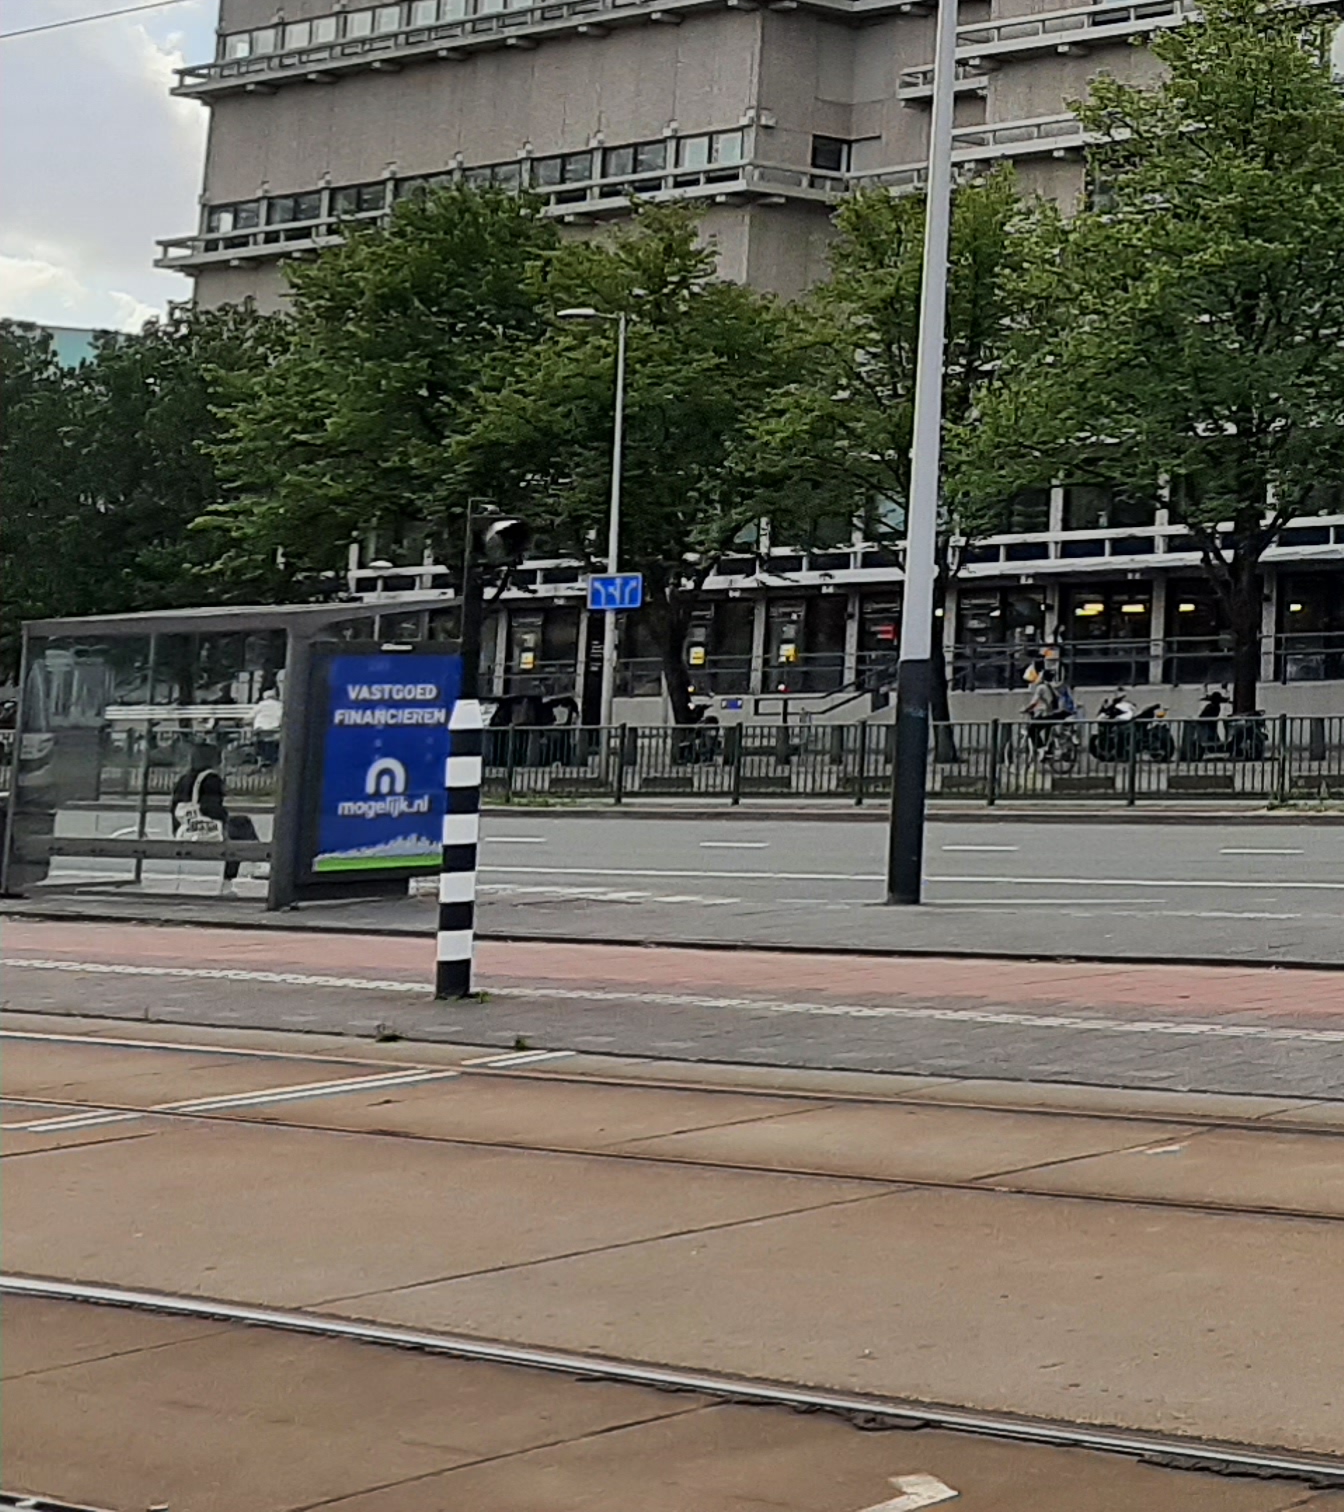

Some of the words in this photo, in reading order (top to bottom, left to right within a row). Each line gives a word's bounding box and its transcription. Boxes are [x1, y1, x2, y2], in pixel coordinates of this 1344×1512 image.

[347, 684, 437, 700] VASTGOED
[334, 708, 446, 724] FINANCIEREN
[337, 795, 429, 819] mogelijk.nl
